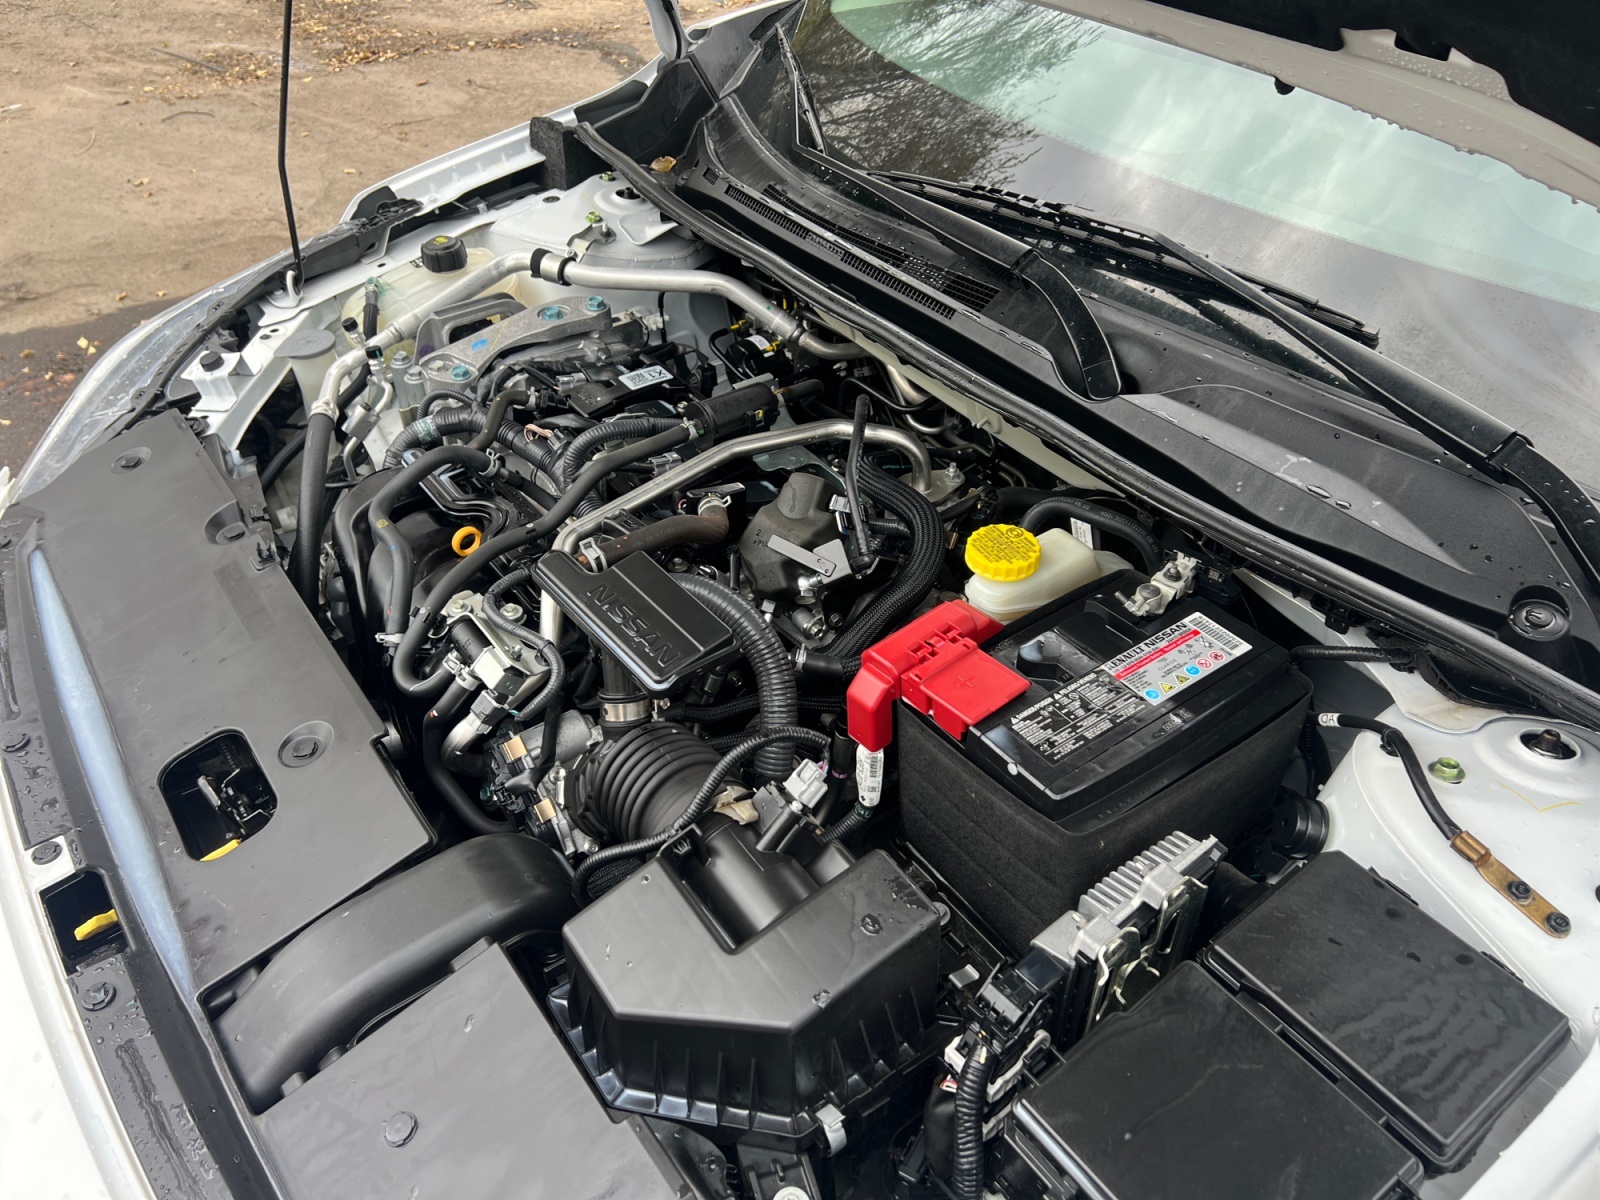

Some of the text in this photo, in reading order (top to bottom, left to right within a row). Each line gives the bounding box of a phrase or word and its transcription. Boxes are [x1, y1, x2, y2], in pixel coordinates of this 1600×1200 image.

[648, 369, 665, 378] X1
[587, 583, 682, 667] NISSAN
[1104, 645, 1147, 671] RENAULT
[1143, 622, 1188, 649] NISSAN
